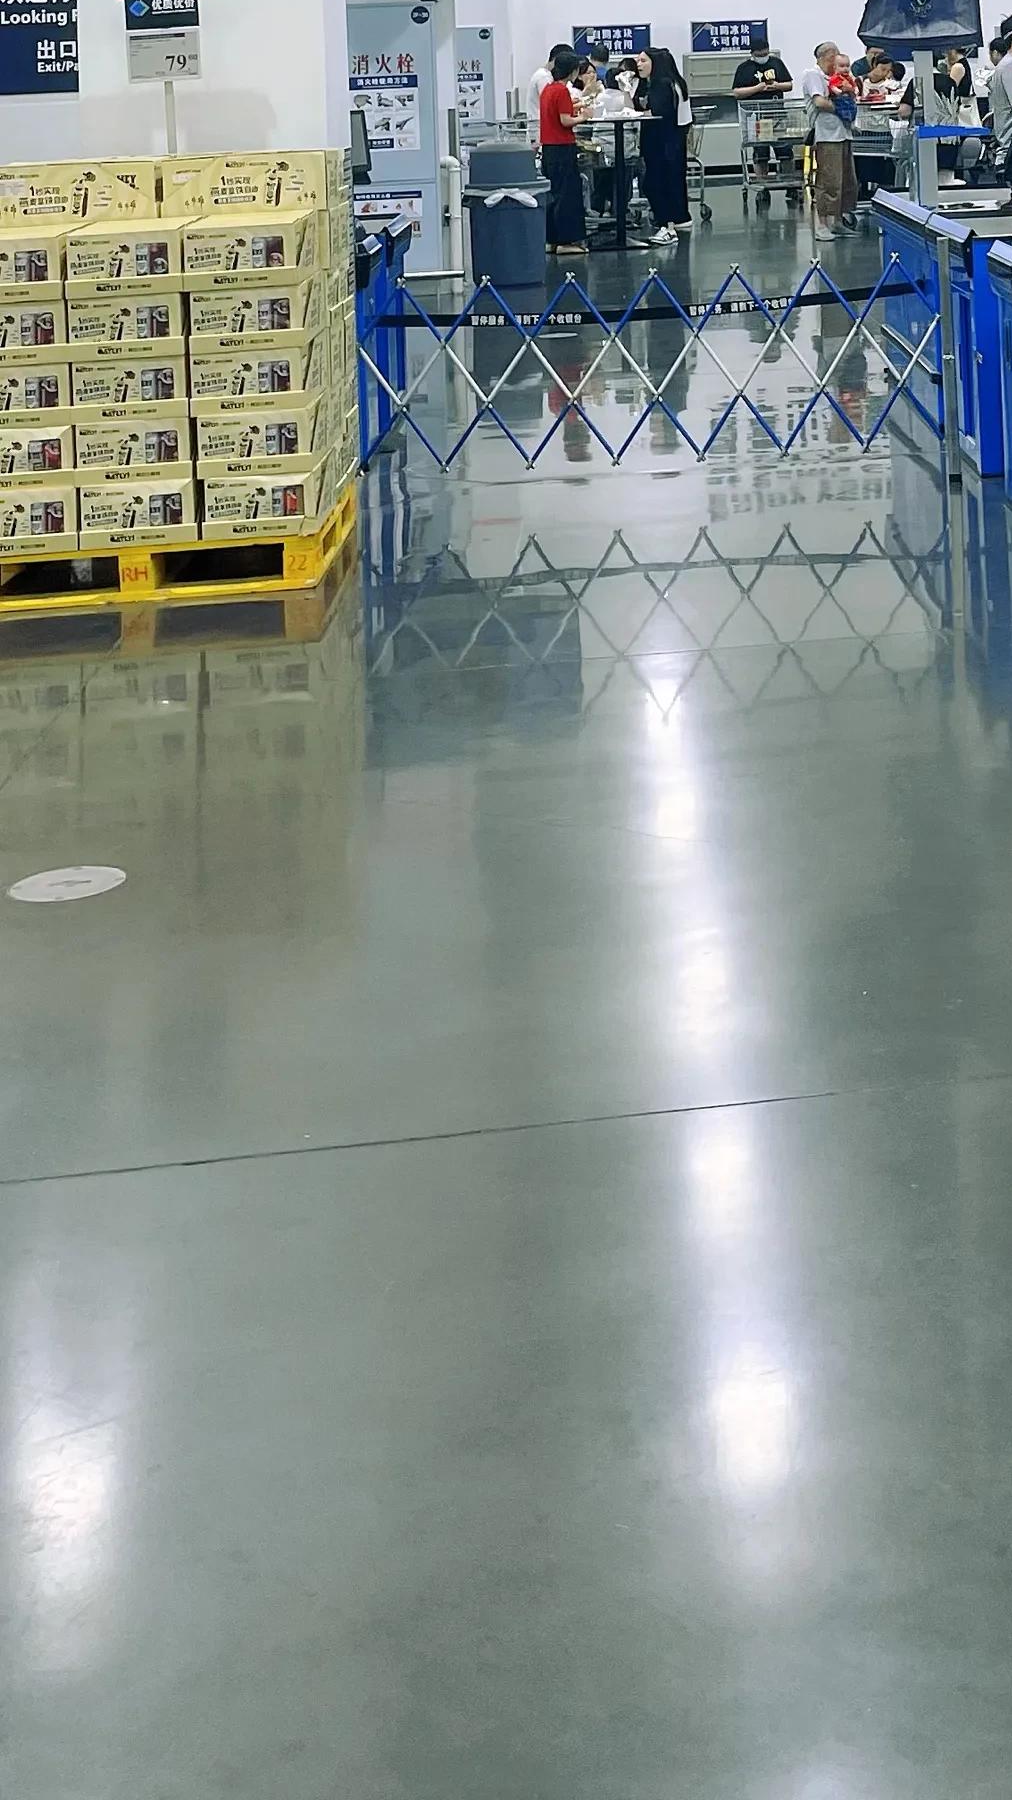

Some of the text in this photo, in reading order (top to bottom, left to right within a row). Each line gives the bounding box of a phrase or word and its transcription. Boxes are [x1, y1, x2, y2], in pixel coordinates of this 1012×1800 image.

[1, 9, 68, 26] Looking
[37, 39, 77, 60] 出口
[165, 55, 187, 71] 79
[352, 53, 414, 75] 消火栓
[288, 555, 307, 571] 22
[120, 566, 148, 582] RH
